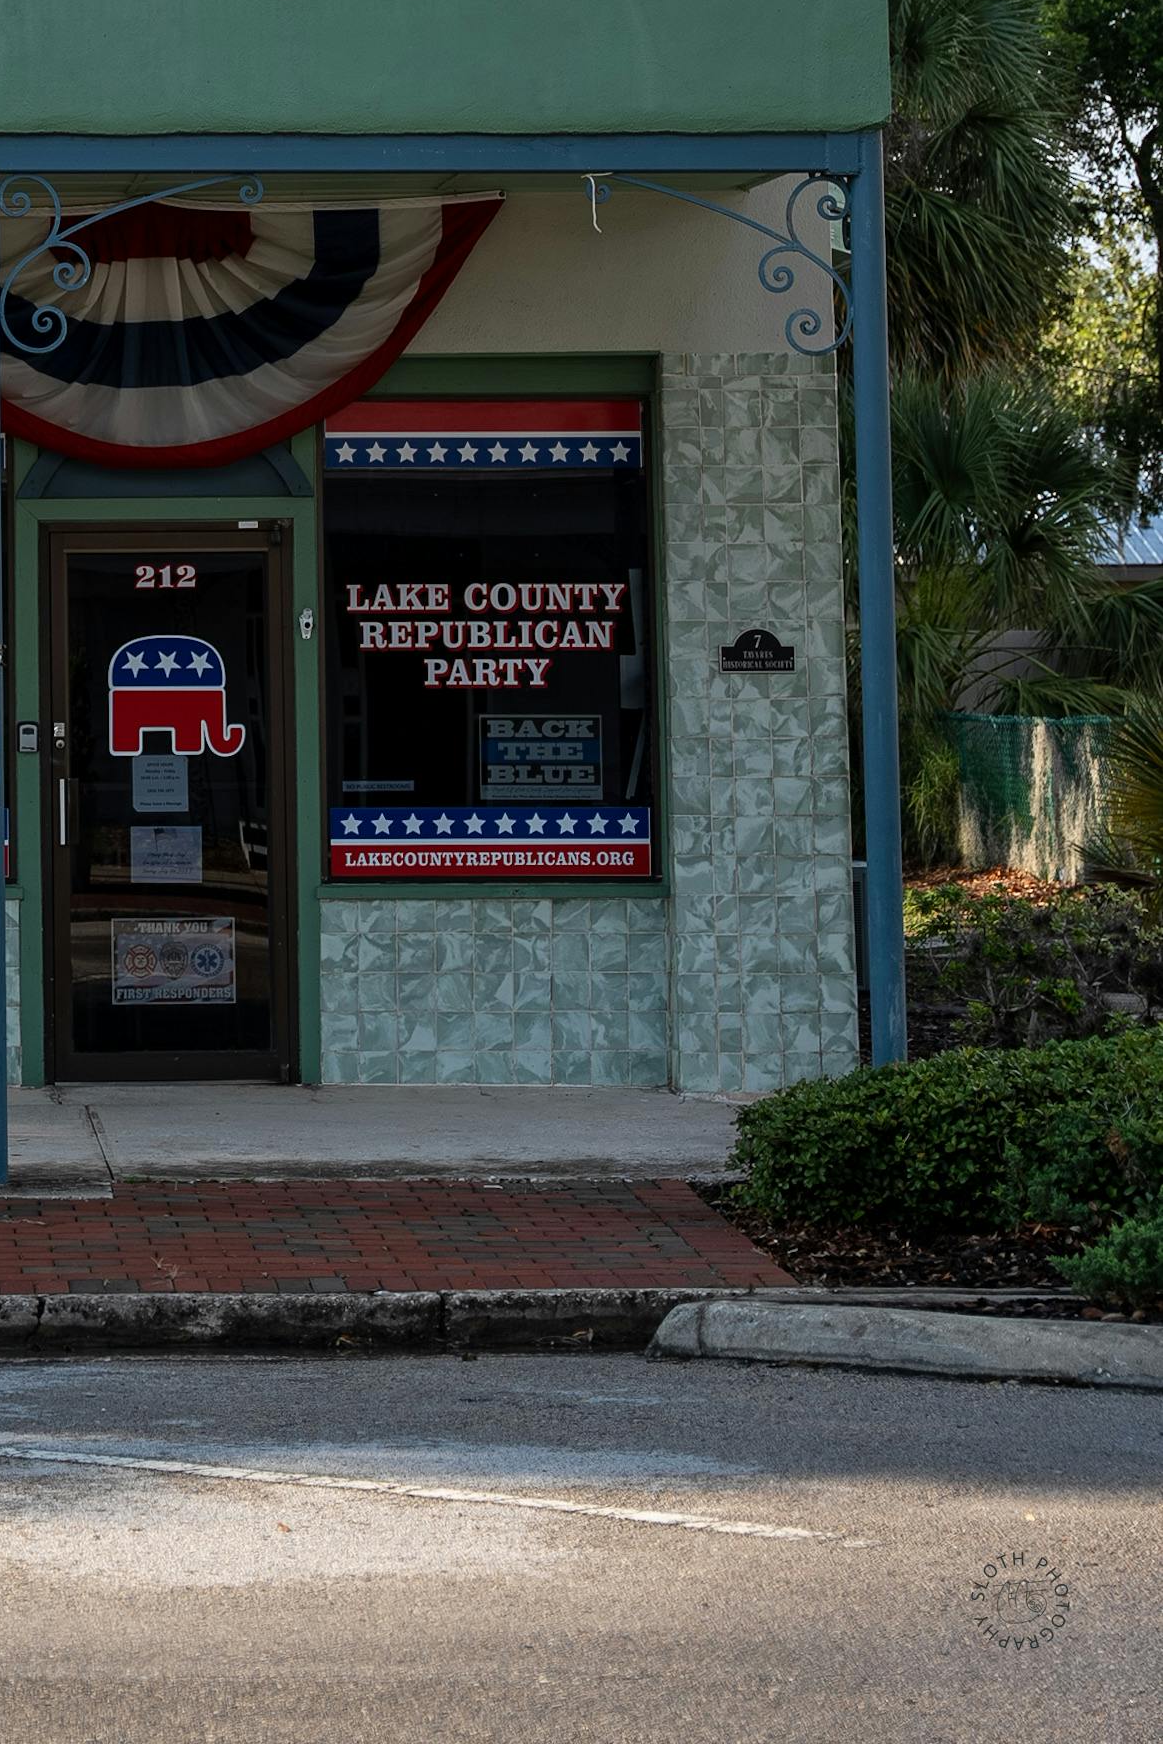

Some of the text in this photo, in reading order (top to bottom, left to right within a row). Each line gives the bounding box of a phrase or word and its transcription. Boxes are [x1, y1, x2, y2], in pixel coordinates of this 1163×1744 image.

[134, 564, 197, 590] 212
[346, 582, 625, 614] LAKE COUNTY
[359, 620, 615, 652] REPUBLICAN
[753, 634, 762, 648] 7
[722, 659, 794, 669] HISTORICAL SOCIETY
[742, 650, 774, 660] TAVARES
[423, 658, 551, 689] PARTY
[486, 719, 595, 738] BACK
[497, 742, 584, 761] THE
[486, 764, 595, 783] BLUE
[344, 851, 635, 868] LAKECOUNTYREPUBLICANS.ORG
[137, 921, 208, 934] THANK YOU
[116, 987, 231, 1000] FIRST RESPONDERS
